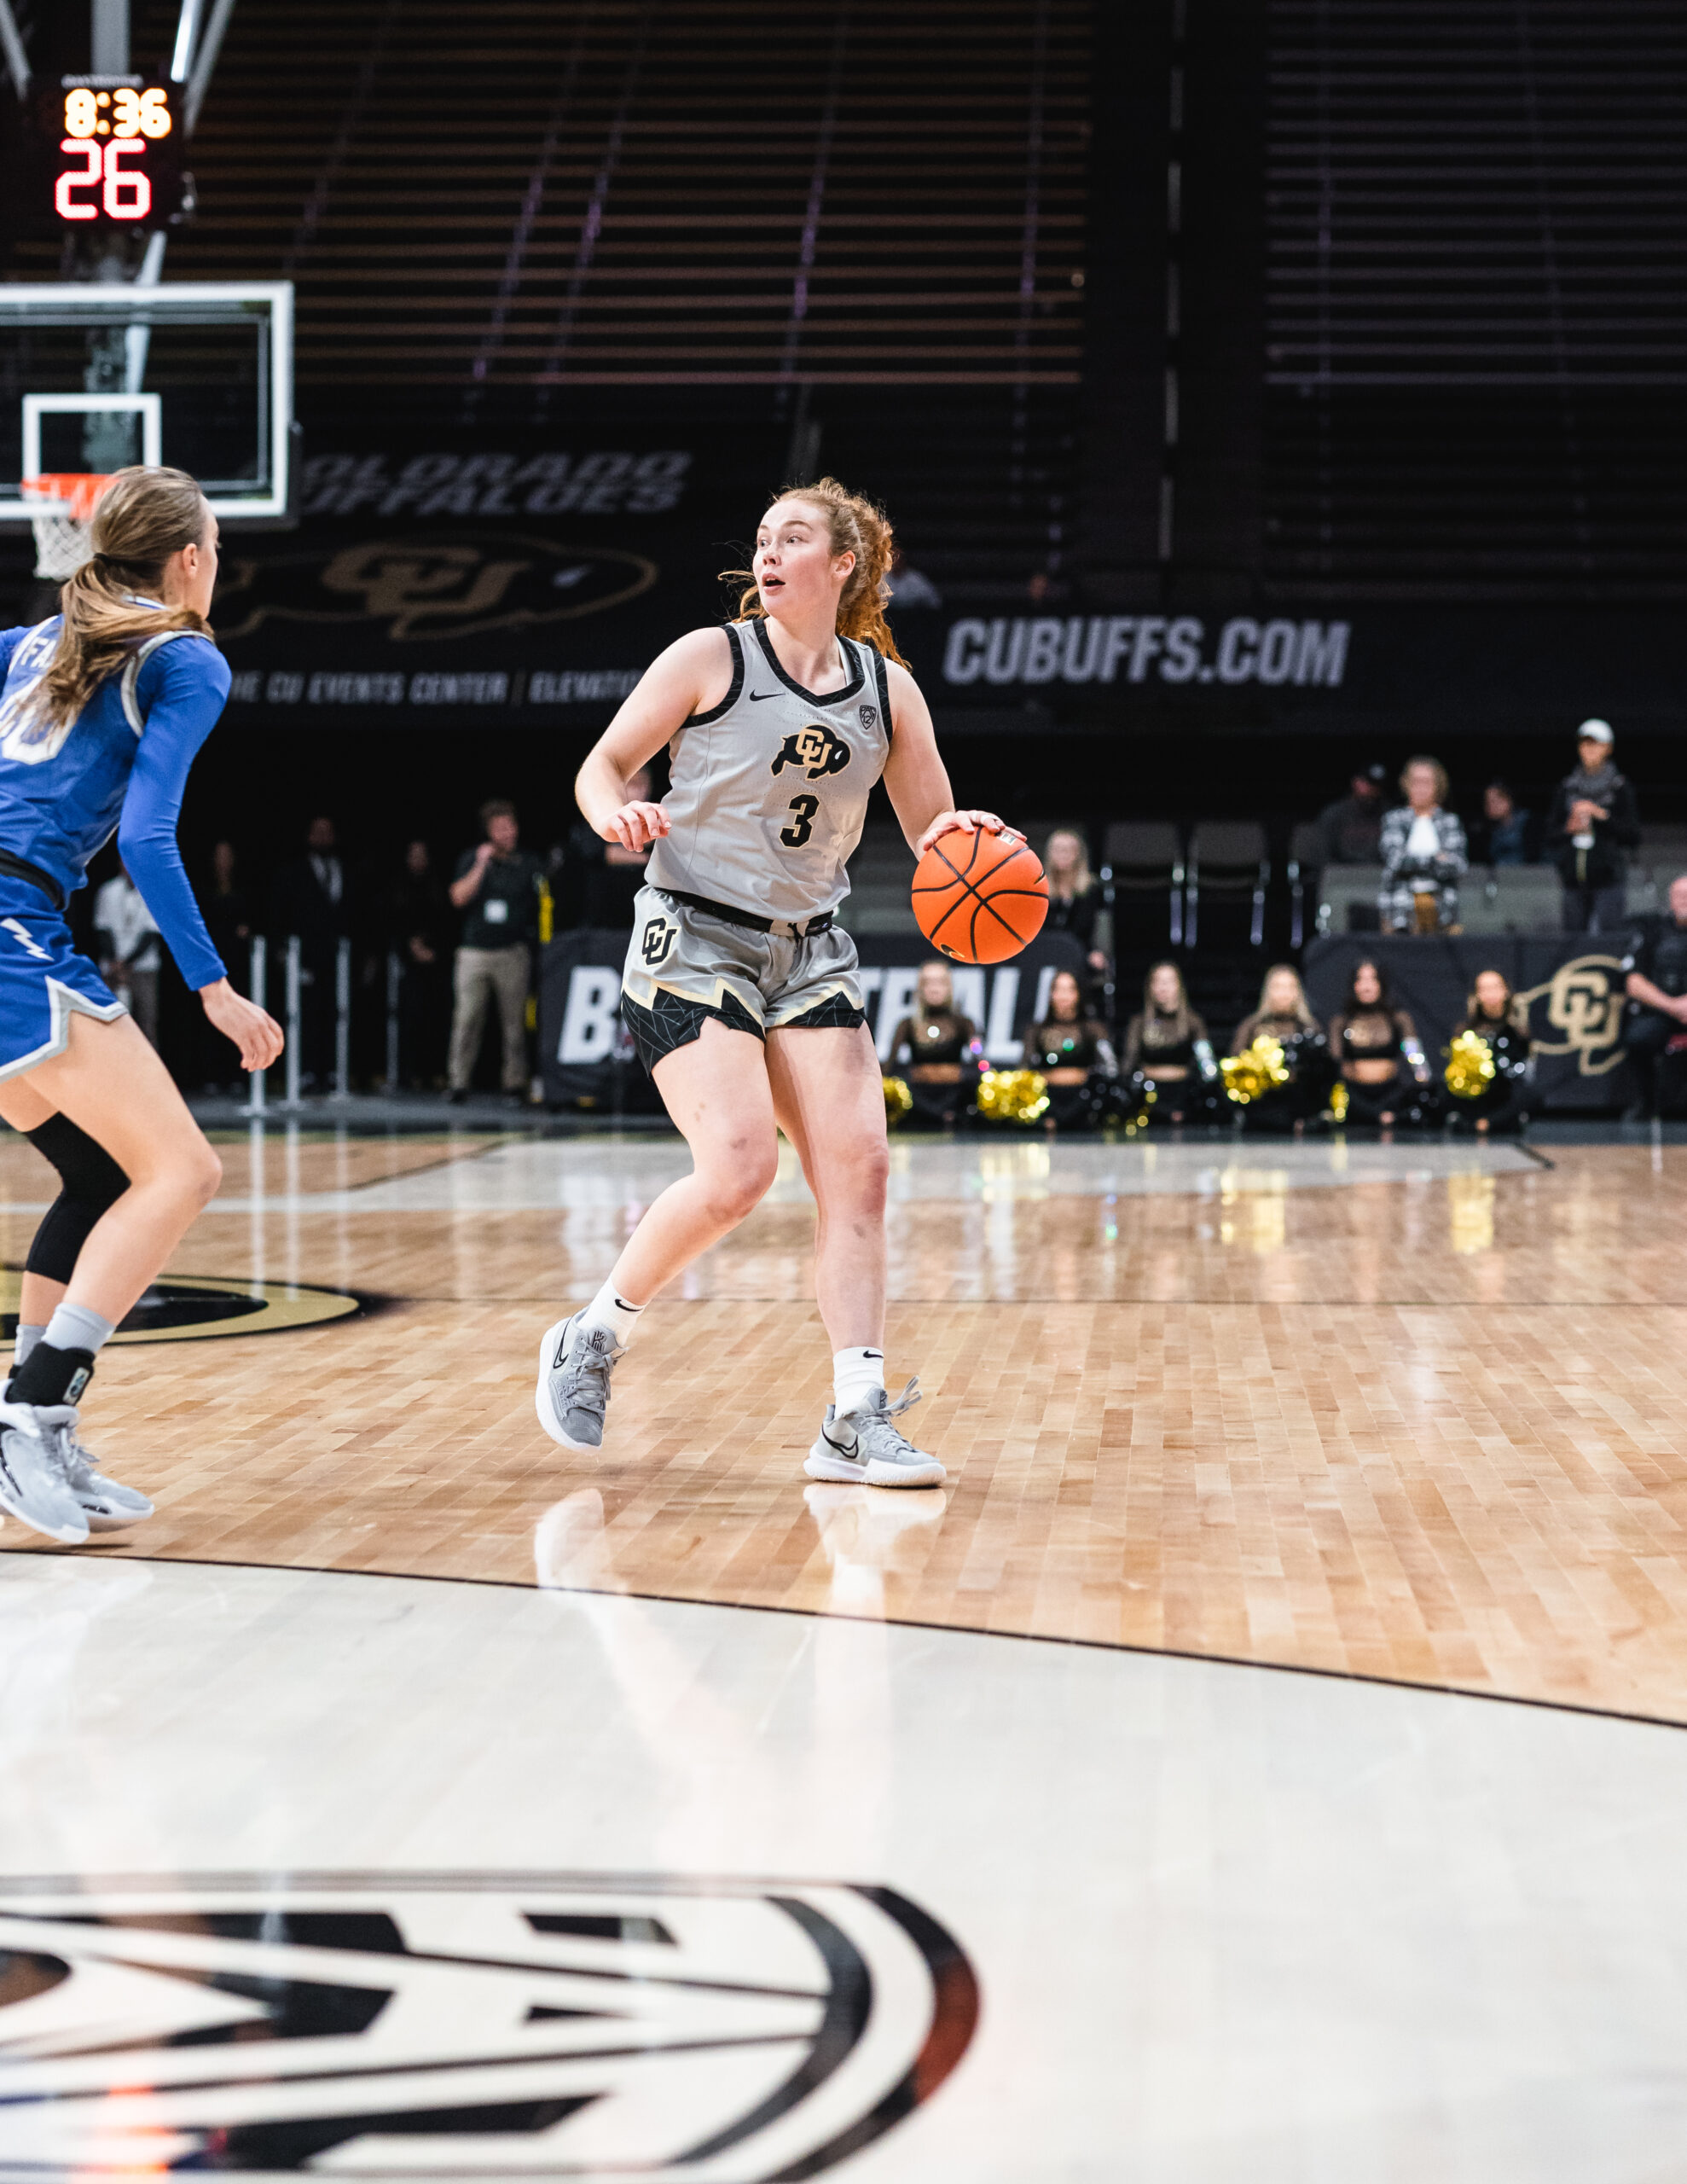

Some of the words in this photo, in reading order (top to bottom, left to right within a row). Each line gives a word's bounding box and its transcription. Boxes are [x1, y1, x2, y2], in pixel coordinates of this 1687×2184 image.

[65, 88, 171, 138] 8:36
[55, 137, 151, 220] 26
[301, 451, 692, 486] OLORADO
[301, 485, 684, 514] UFFALOES
[943, 616, 1351, 687] CUBUFFS.COM
[409, 671, 508, 704] CENTER
[795, 728, 833, 770] CU
[780, 793, 820, 850] 3
[641, 916, 679, 966] CU
[1548, 971, 1625, 1049] CU
